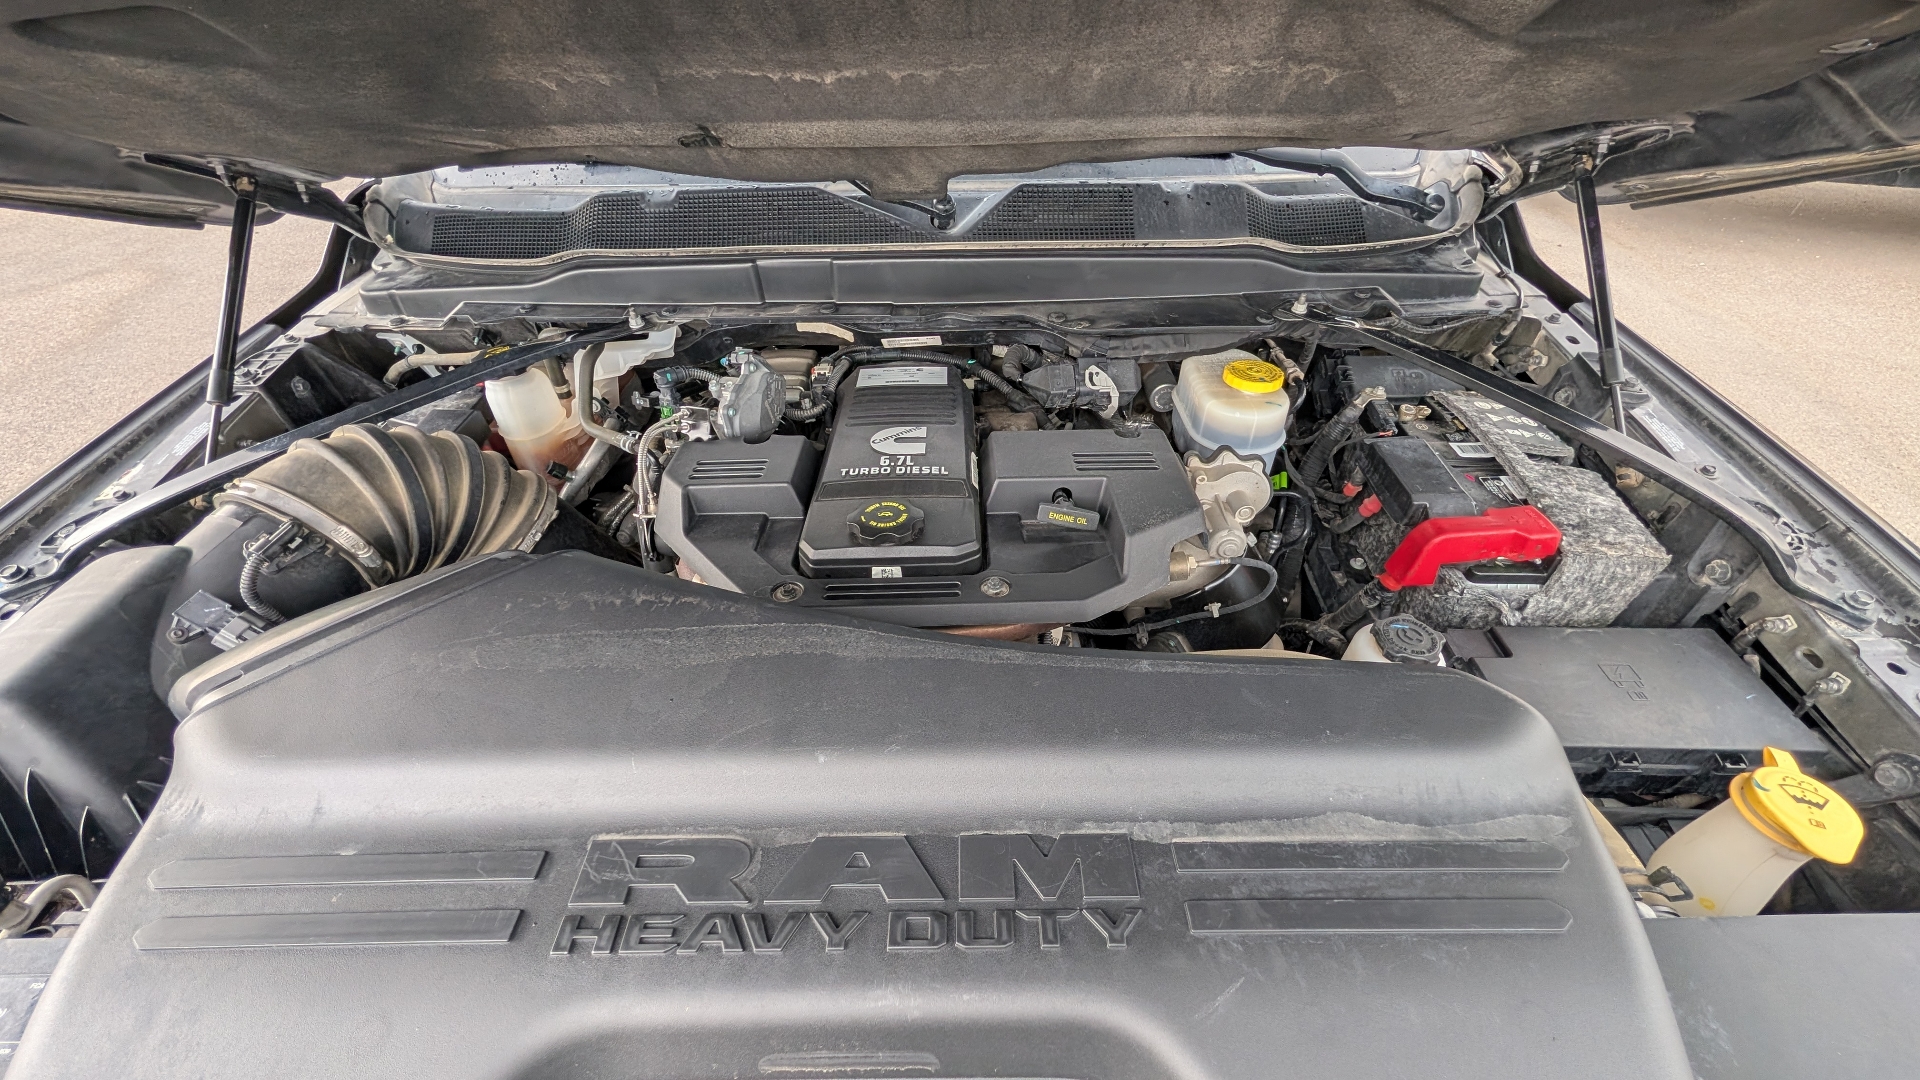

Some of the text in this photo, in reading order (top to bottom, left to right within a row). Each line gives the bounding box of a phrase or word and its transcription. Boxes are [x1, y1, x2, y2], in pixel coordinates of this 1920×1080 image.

[871, 426, 923, 444] Cummins
[880, 456, 914, 466] 6.7L
[840, 466, 949, 476] TURBO DIESEL
[1048, 512, 1088, 525] ENGINE OIL
[567, 833, 1140, 907] RAM
[550, 908, 1143, 955] HEAVY DUTY
